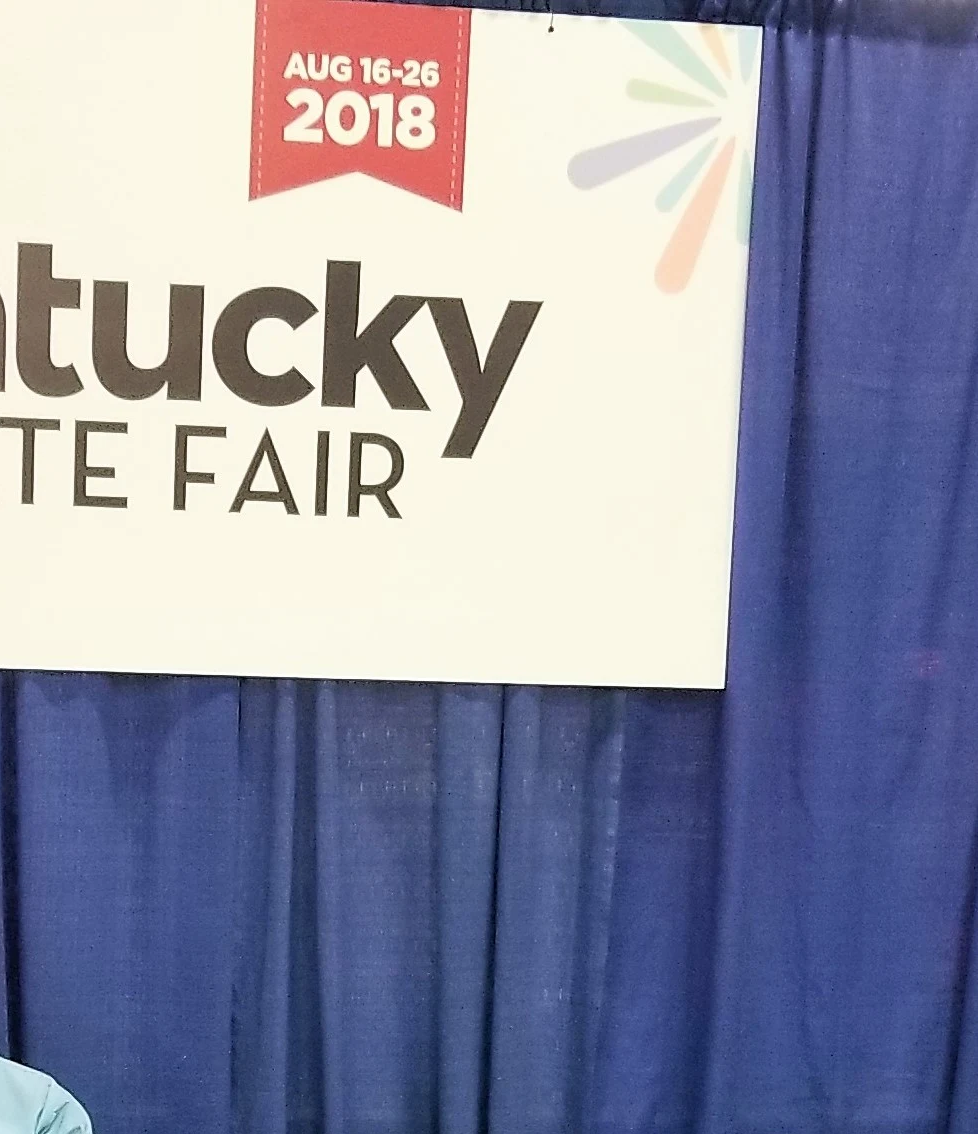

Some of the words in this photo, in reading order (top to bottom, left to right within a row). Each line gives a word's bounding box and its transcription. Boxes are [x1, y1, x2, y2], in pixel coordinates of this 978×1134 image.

[284, 52, 353, 83] AUG
[359, 57, 440, 88] 16-26
[282, 88, 437, 150] 2018
[172, 424, 405, 519] FAIR
